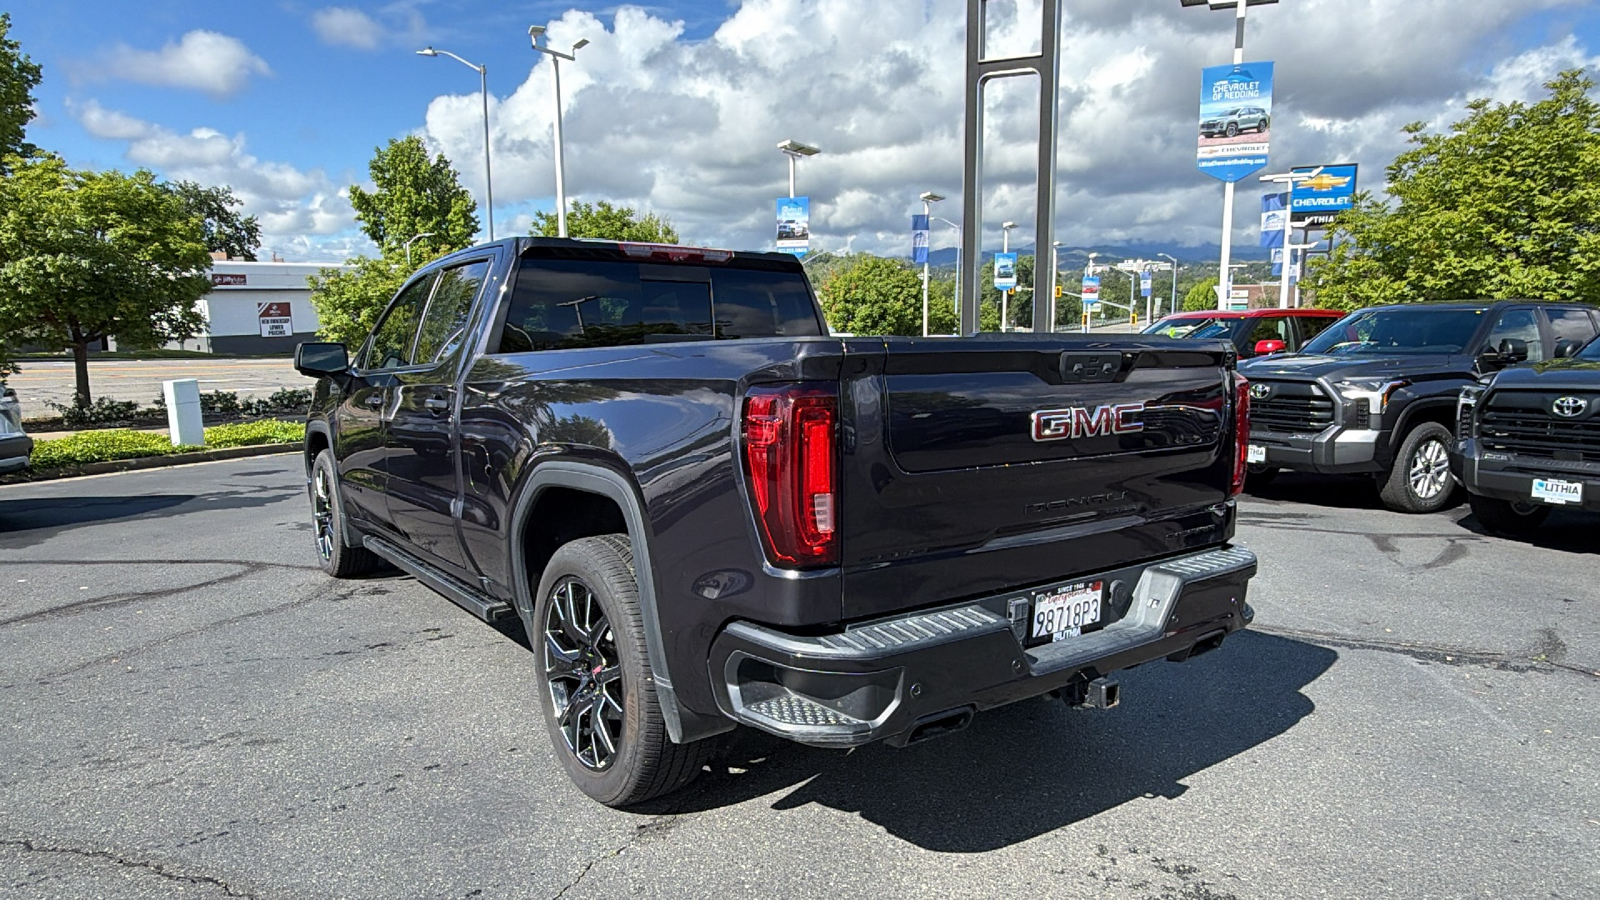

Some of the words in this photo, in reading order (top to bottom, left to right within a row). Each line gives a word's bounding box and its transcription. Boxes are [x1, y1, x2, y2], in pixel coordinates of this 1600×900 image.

[1212, 81, 1260, 93] CHEVROLET
[1212, 92, 1223, 101] OF
[1224, 89, 1259, 100] REDDING
[1221, 145, 1266, 153] CHEVROLET
[1292, 196, 1350, 207] CHEVROLET
[1031, 403, 1145, 443] GMC
[1545, 483, 1579, 495] LITHIA
[1022, 489, 1130, 515] DENALI
[1057, 585, 1073, 593] SINCE
[1036, 598, 1098, 636] 98718P3
